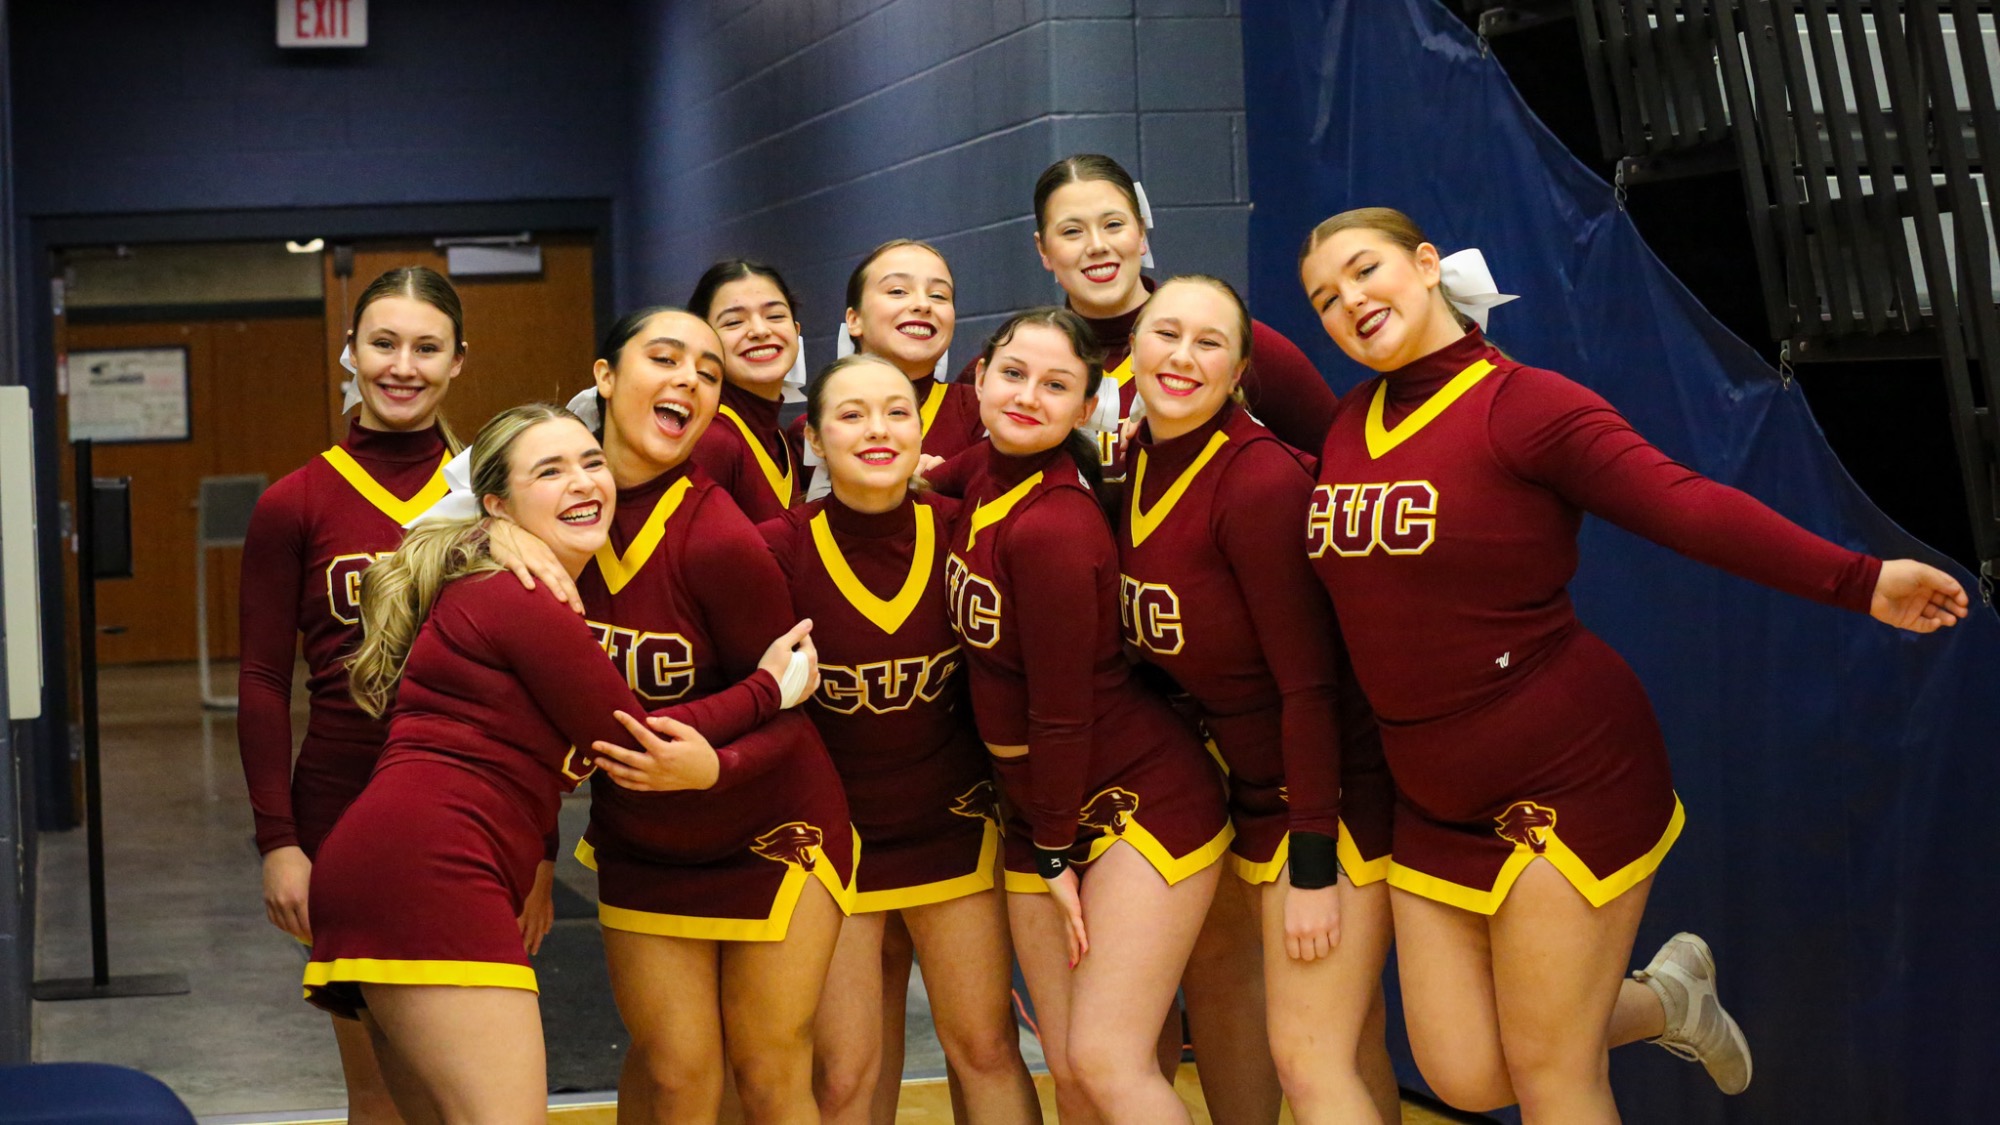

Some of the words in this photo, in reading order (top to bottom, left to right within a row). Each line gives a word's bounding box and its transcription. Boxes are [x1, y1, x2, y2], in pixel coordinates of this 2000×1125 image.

[295, 0, 349, 38] EXIT
[1306, 480, 1439, 558] CUC
[945, 552, 1001, 649] UC
[1120, 573, 1185, 655] UC
